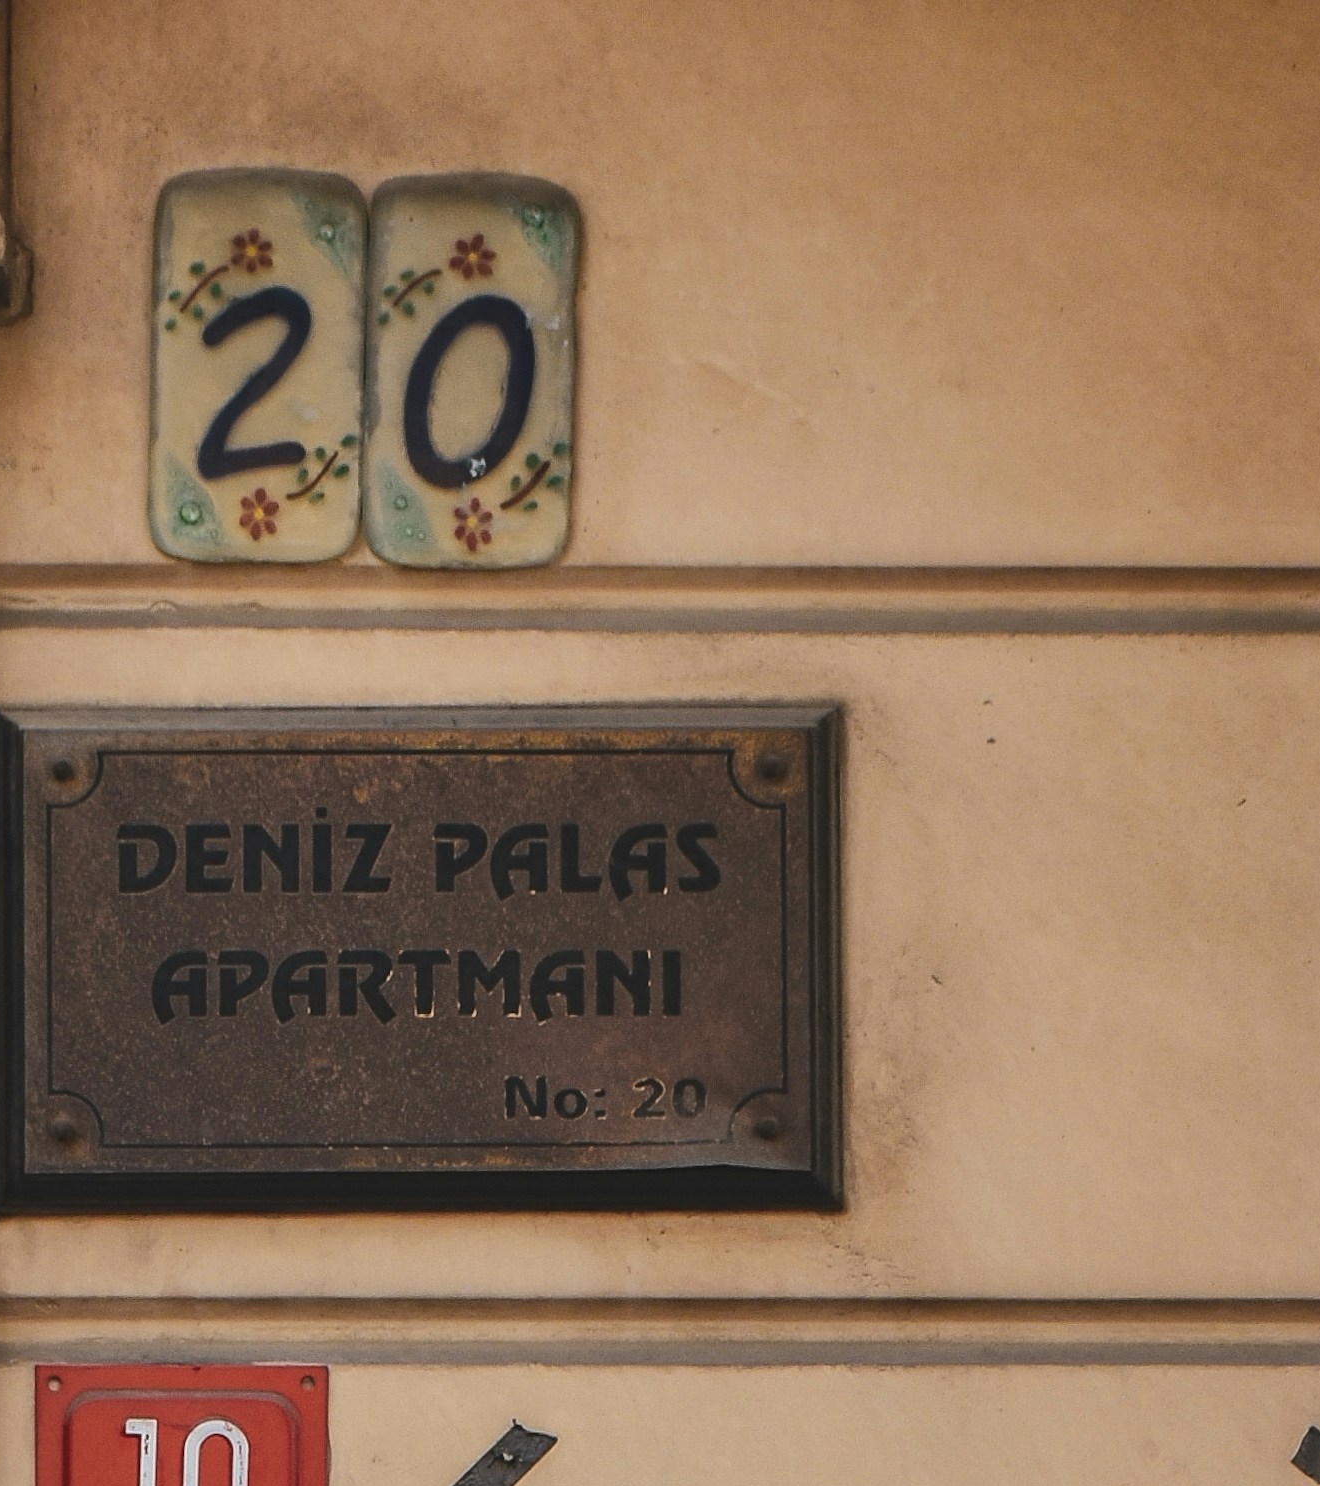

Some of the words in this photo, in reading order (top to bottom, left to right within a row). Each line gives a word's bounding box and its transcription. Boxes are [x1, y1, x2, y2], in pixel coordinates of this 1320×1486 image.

[197, 284, 537, 490] 20
[115, 805, 395, 896] DENİZ
[432, 821, 724, 901] PALAS
[151, 946, 684, 1027] APARTMANI
[502, 1074, 608, 1122] No:
[631, 1076, 710, 1121] 20
